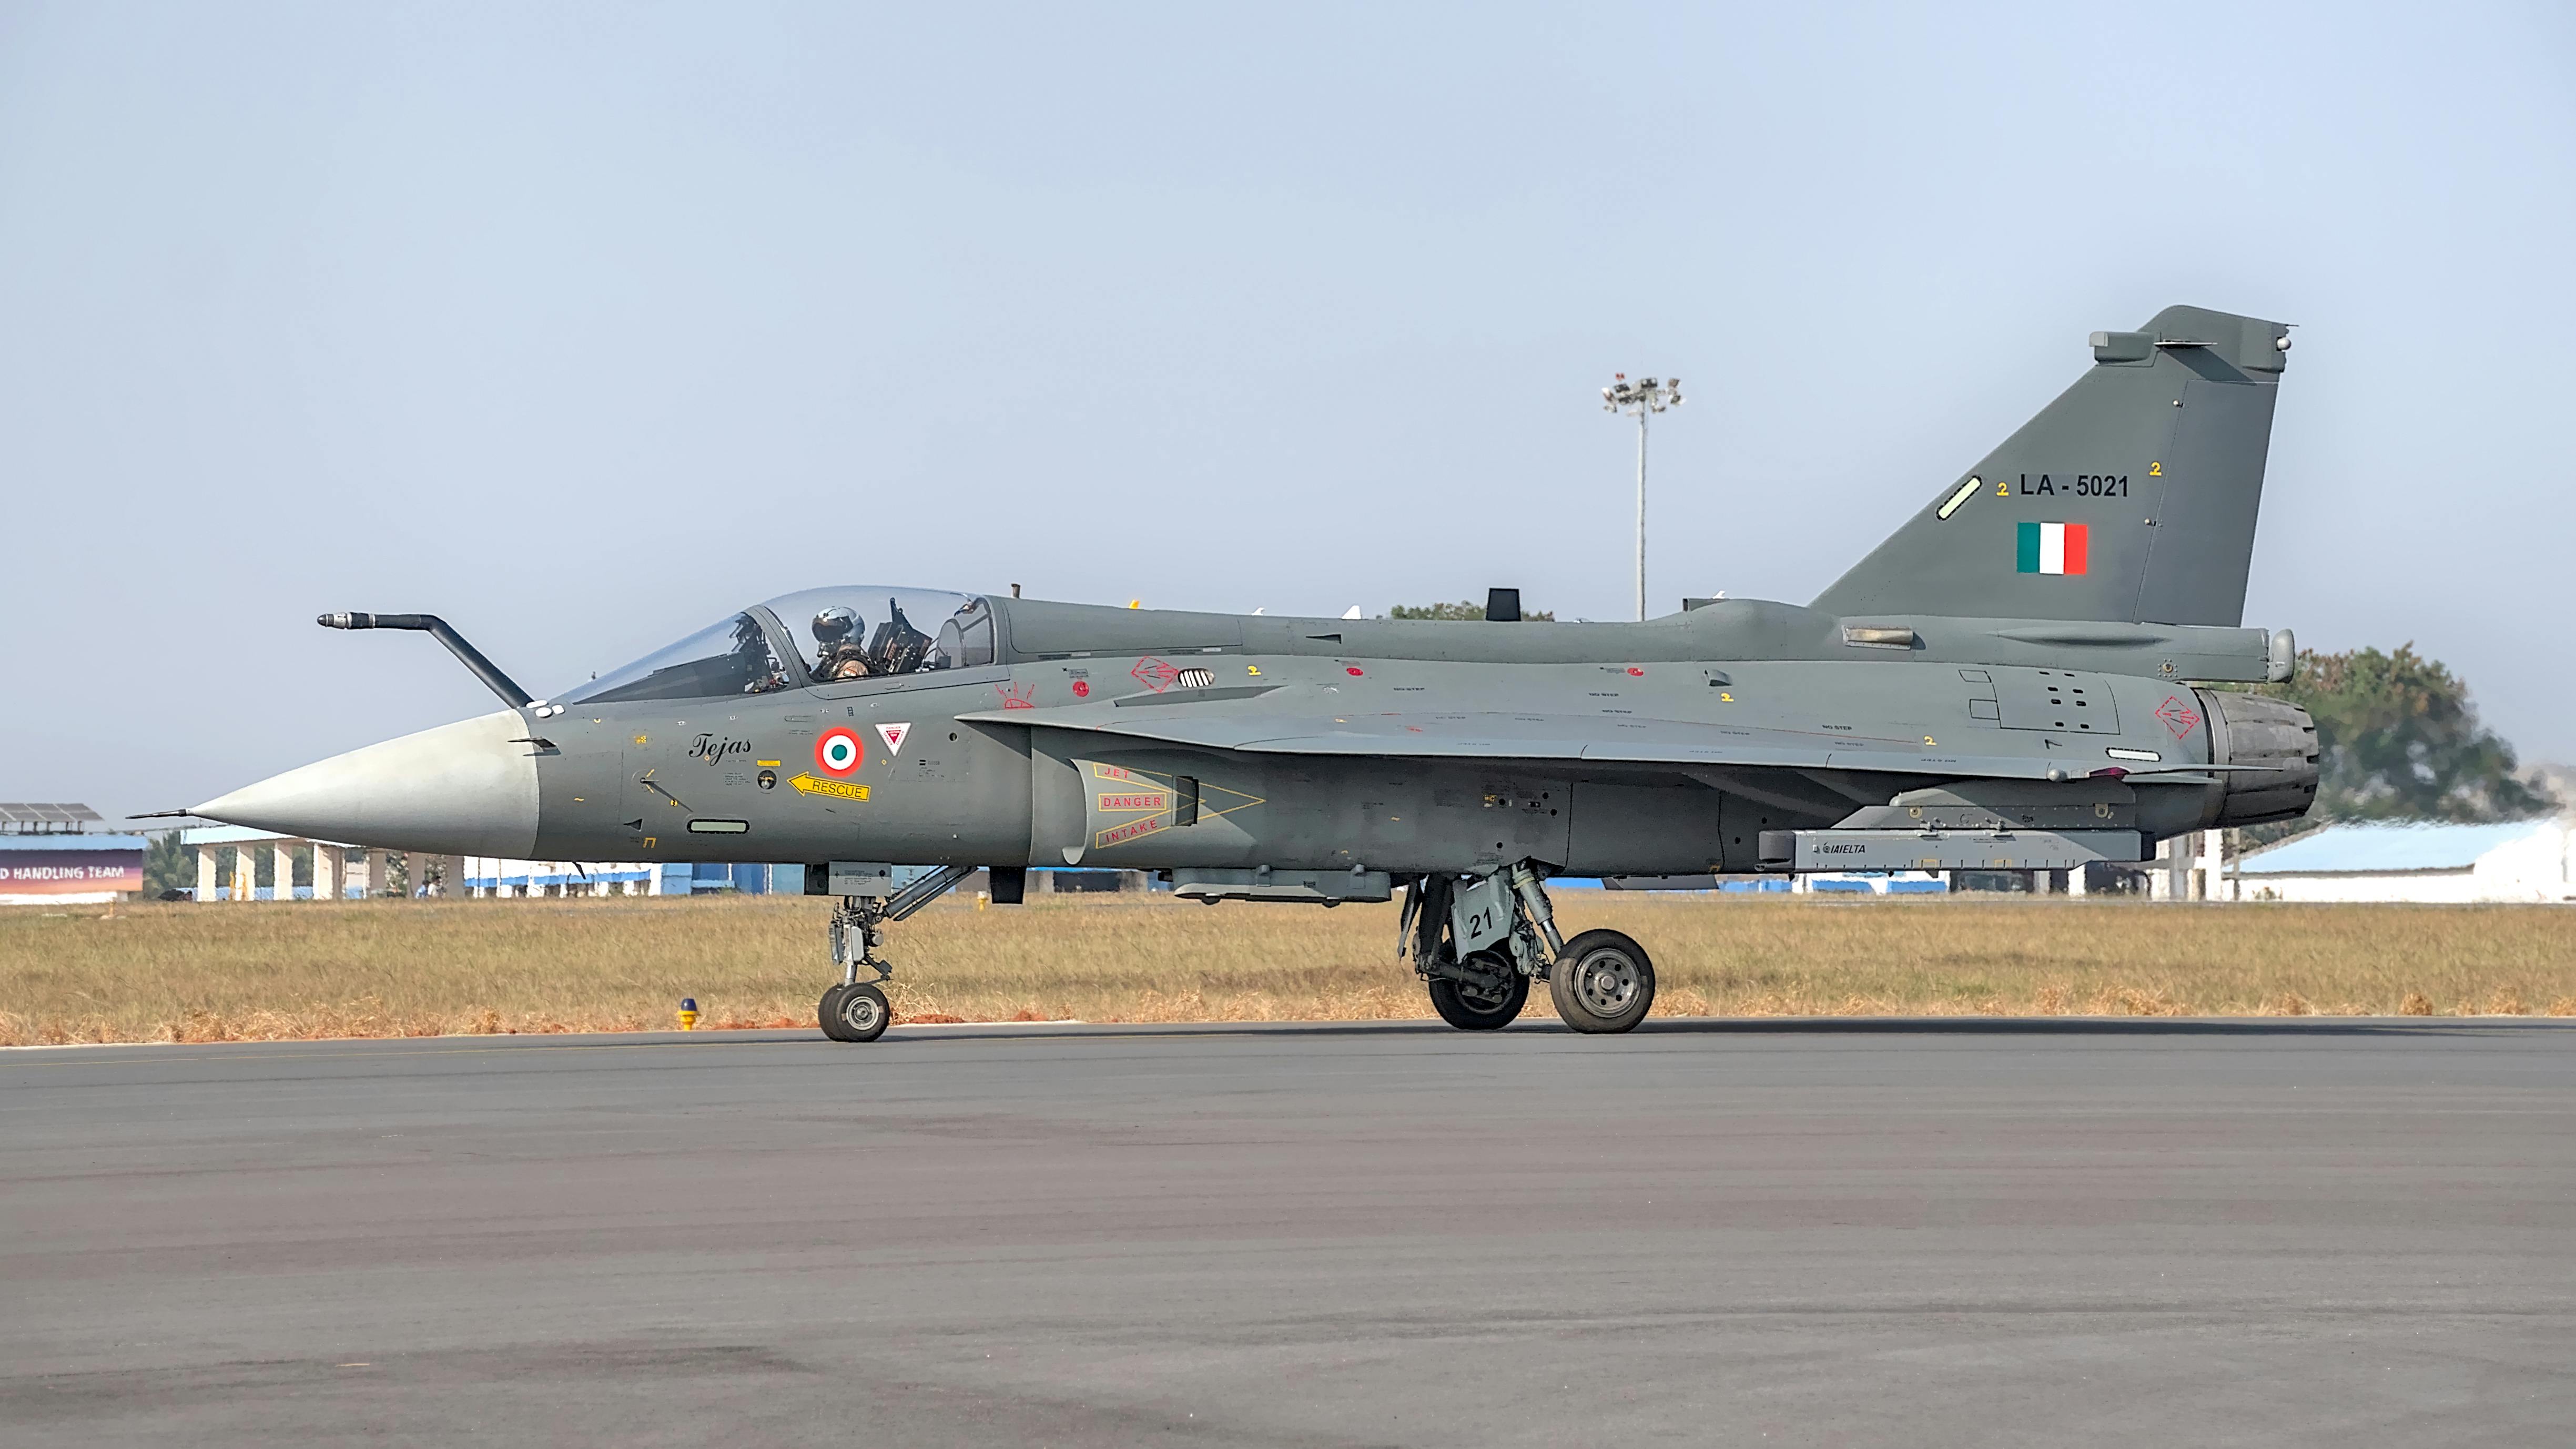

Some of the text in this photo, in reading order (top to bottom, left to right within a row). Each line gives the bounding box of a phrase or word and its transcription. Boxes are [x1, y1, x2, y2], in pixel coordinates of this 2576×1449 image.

[2149, 461, 2162, 476] 2
[1996, 482, 2010, 496] 2
[2020, 473, 2055, 495] LA
[2076, 474, 2128, 498] 5021
[1247, 665, 1262, 676] 2
[1720, 692, 1735, 702] 2
[1923, 735, 1938, 746] 2
[688, 733, 752, 766] Tejas
[1104, 767, 1129, 778] JET
[812, 781, 863, 797] RESCUE
[1104, 797, 1161, 807] DANGER
[1106, 819, 1158, 842] INTAKE
[13, 866, 85, 880] HANDLING
[87, 866, 125, 878] TEAM
[1469, 906, 1492, 940] 21
